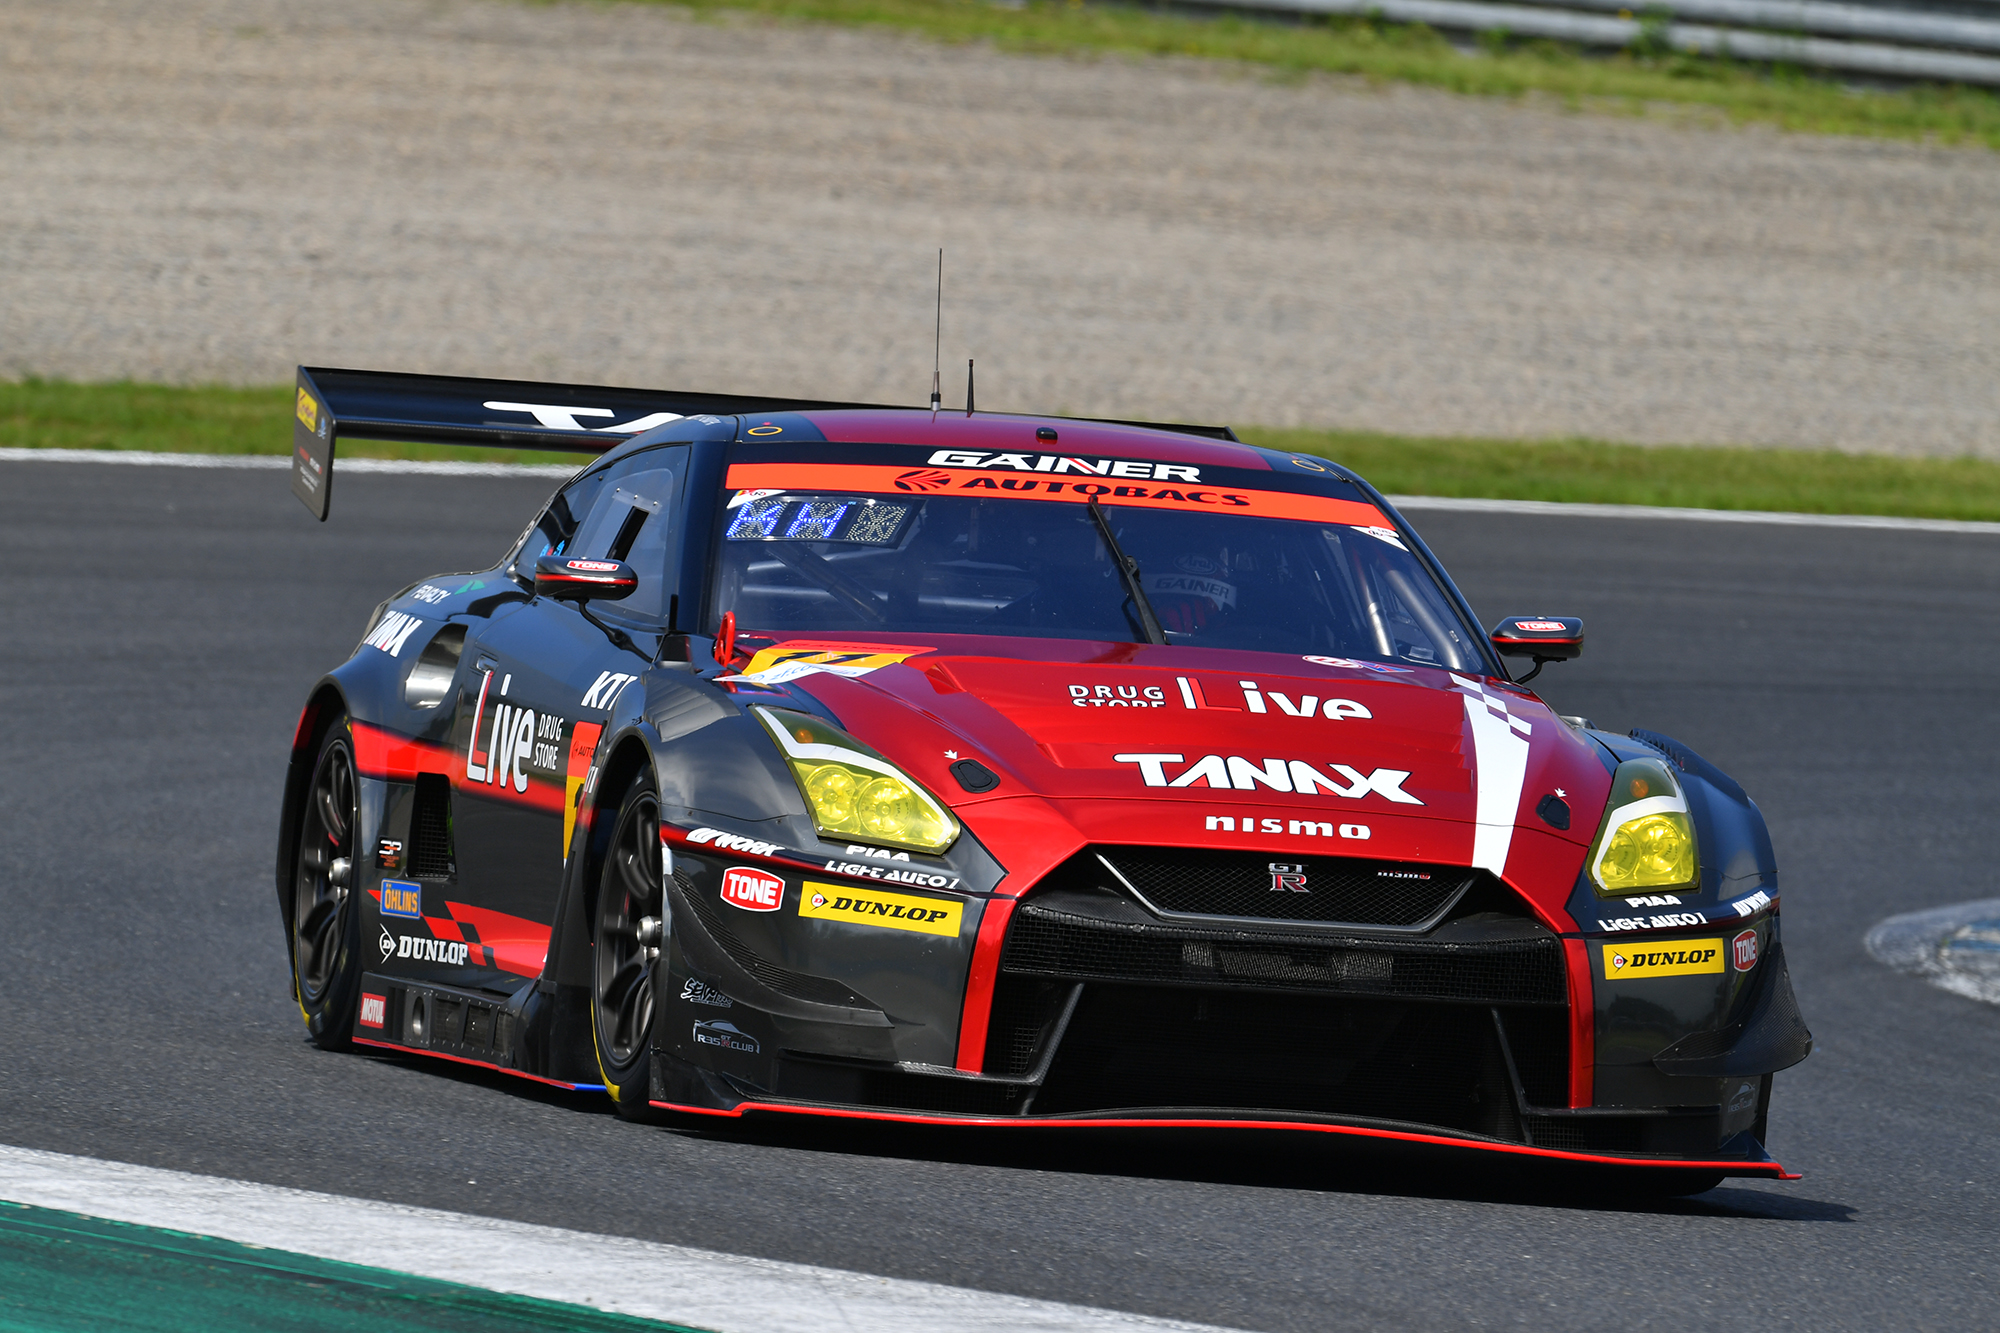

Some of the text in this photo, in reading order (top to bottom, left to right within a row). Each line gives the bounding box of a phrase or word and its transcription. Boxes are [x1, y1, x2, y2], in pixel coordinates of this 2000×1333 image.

[927, 450, 1201, 482] GAINER
[957, 477, 1249, 505] AUTOBACS
[572, 562, 613, 570] TONE
[1155, 578, 1230, 599] GAINER
[1067, 684, 1165, 700] DRUG
[1176, 677, 1373, 720] Live
[467, 670, 535, 793] Live
[538, 713, 564, 742] DRUG
[533, 743, 559, 771] STORE
[1113, 753, 1427, 806] TANAX
[1205, 815, 1371, 840] nismo
[714, 831, 786, 857] WORK
[845, 845, 910, 862] PIAA
[1268, 863, 1309, 873] GT
[729, 872, 779, 905] TONE
[1269, 873, 1310, 893] R
[384, 884, 418, 913] ÖHLINS
[831, 896, 948, 924] DUNLOP
[1625, 895, 1682, 908] PIAA
[397, 936, 468, 965] DUNLOP
[1630, 949, 1716, 968] DUNLOP
[1736, 937, 1756, 964] TONE
[361, 998, 384, 1023] MOTUL
[698, 1034, 720, 1046] R35
[731, 1041, 754, 1053] CLUB
